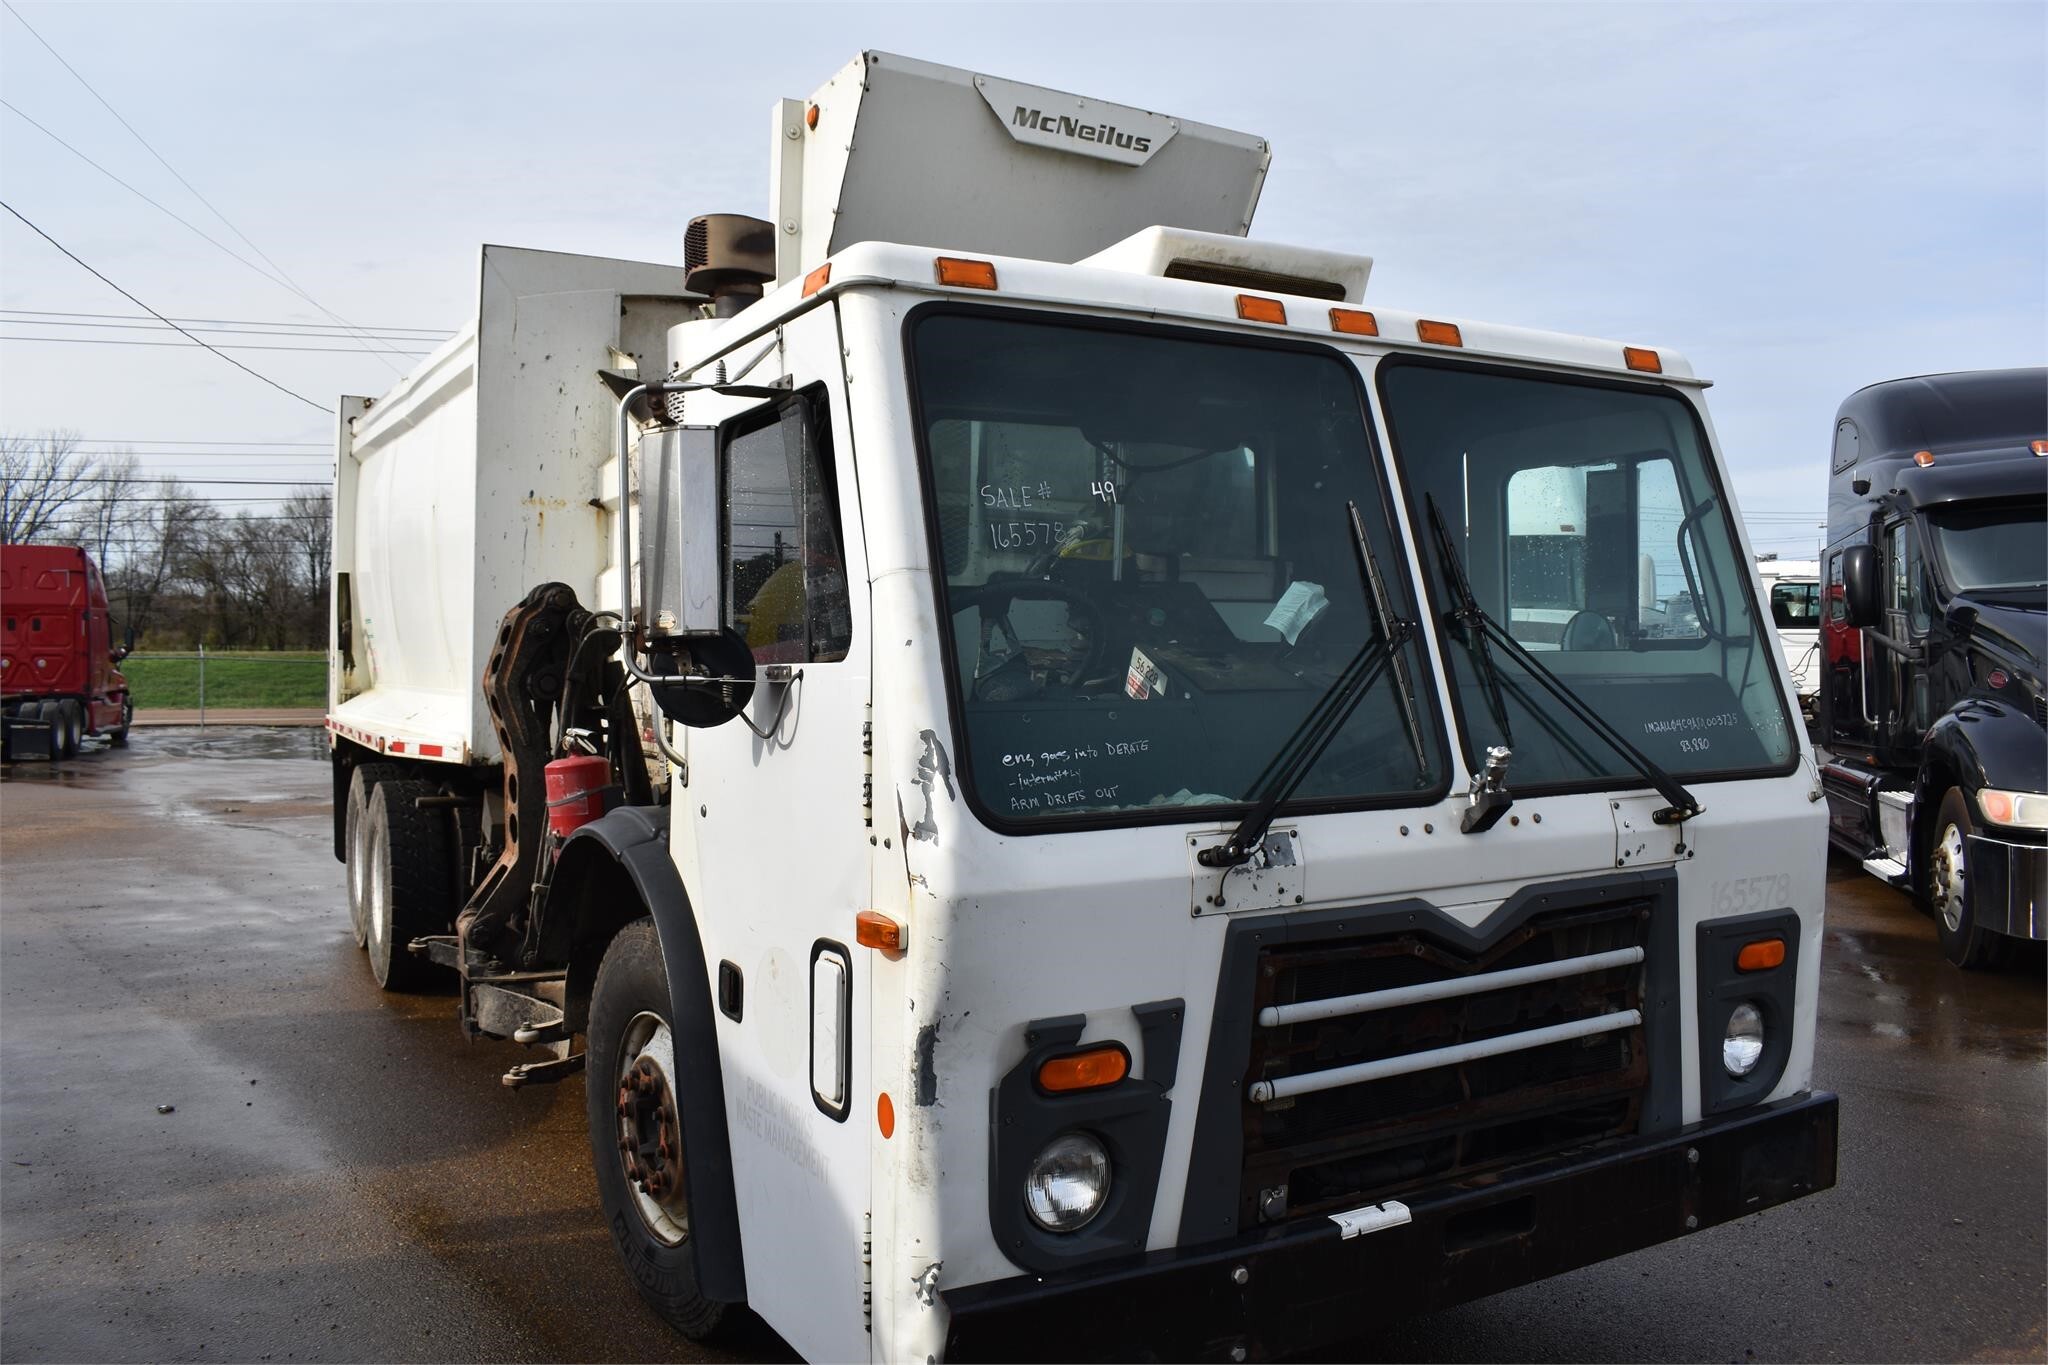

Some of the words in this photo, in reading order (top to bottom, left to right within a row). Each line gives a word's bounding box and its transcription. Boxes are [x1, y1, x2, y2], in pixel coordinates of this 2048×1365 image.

[1012, 106, 1152, 153] McNeilus
[981, 485, 1032, 507] SALE
[1091, 481, 1117, 503] 49
[991, 522, 1067, 549] 165578
[1002, 753, 1034, 767] eng
[1074, 744, 1098, 760] into
[1105, 739, 1150, 756] DERATE
[1011, 796, 1040, 811] ARM
[1044, 789, 1087, 807] DRIFTS
[1095, 785, 1119, 799] OUT
[1710, 872, 1792, 917] 165578
